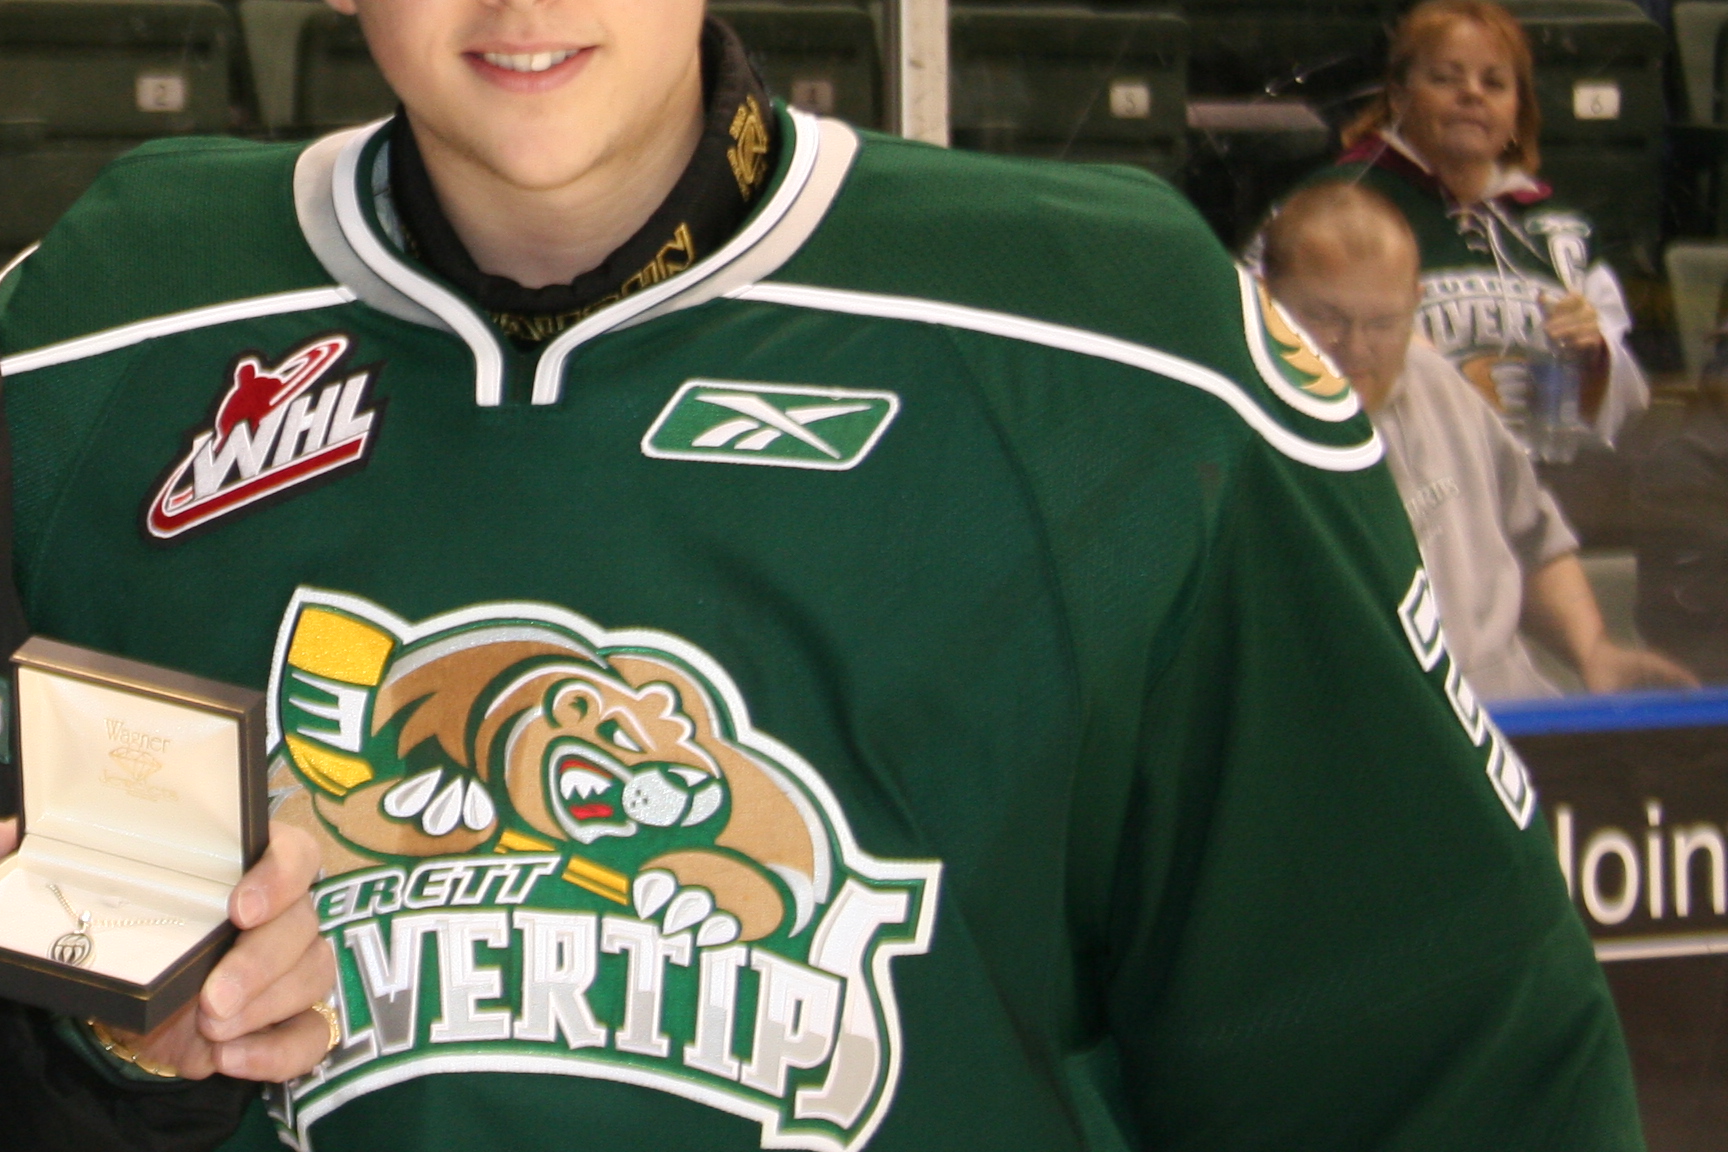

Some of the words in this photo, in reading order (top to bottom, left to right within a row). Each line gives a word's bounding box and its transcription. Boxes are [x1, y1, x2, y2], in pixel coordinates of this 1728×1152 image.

[192, 373, 375, 501] WHL
[103, 717, 172, 754] Wagner
[315, 854, 565, 931] ERETT
